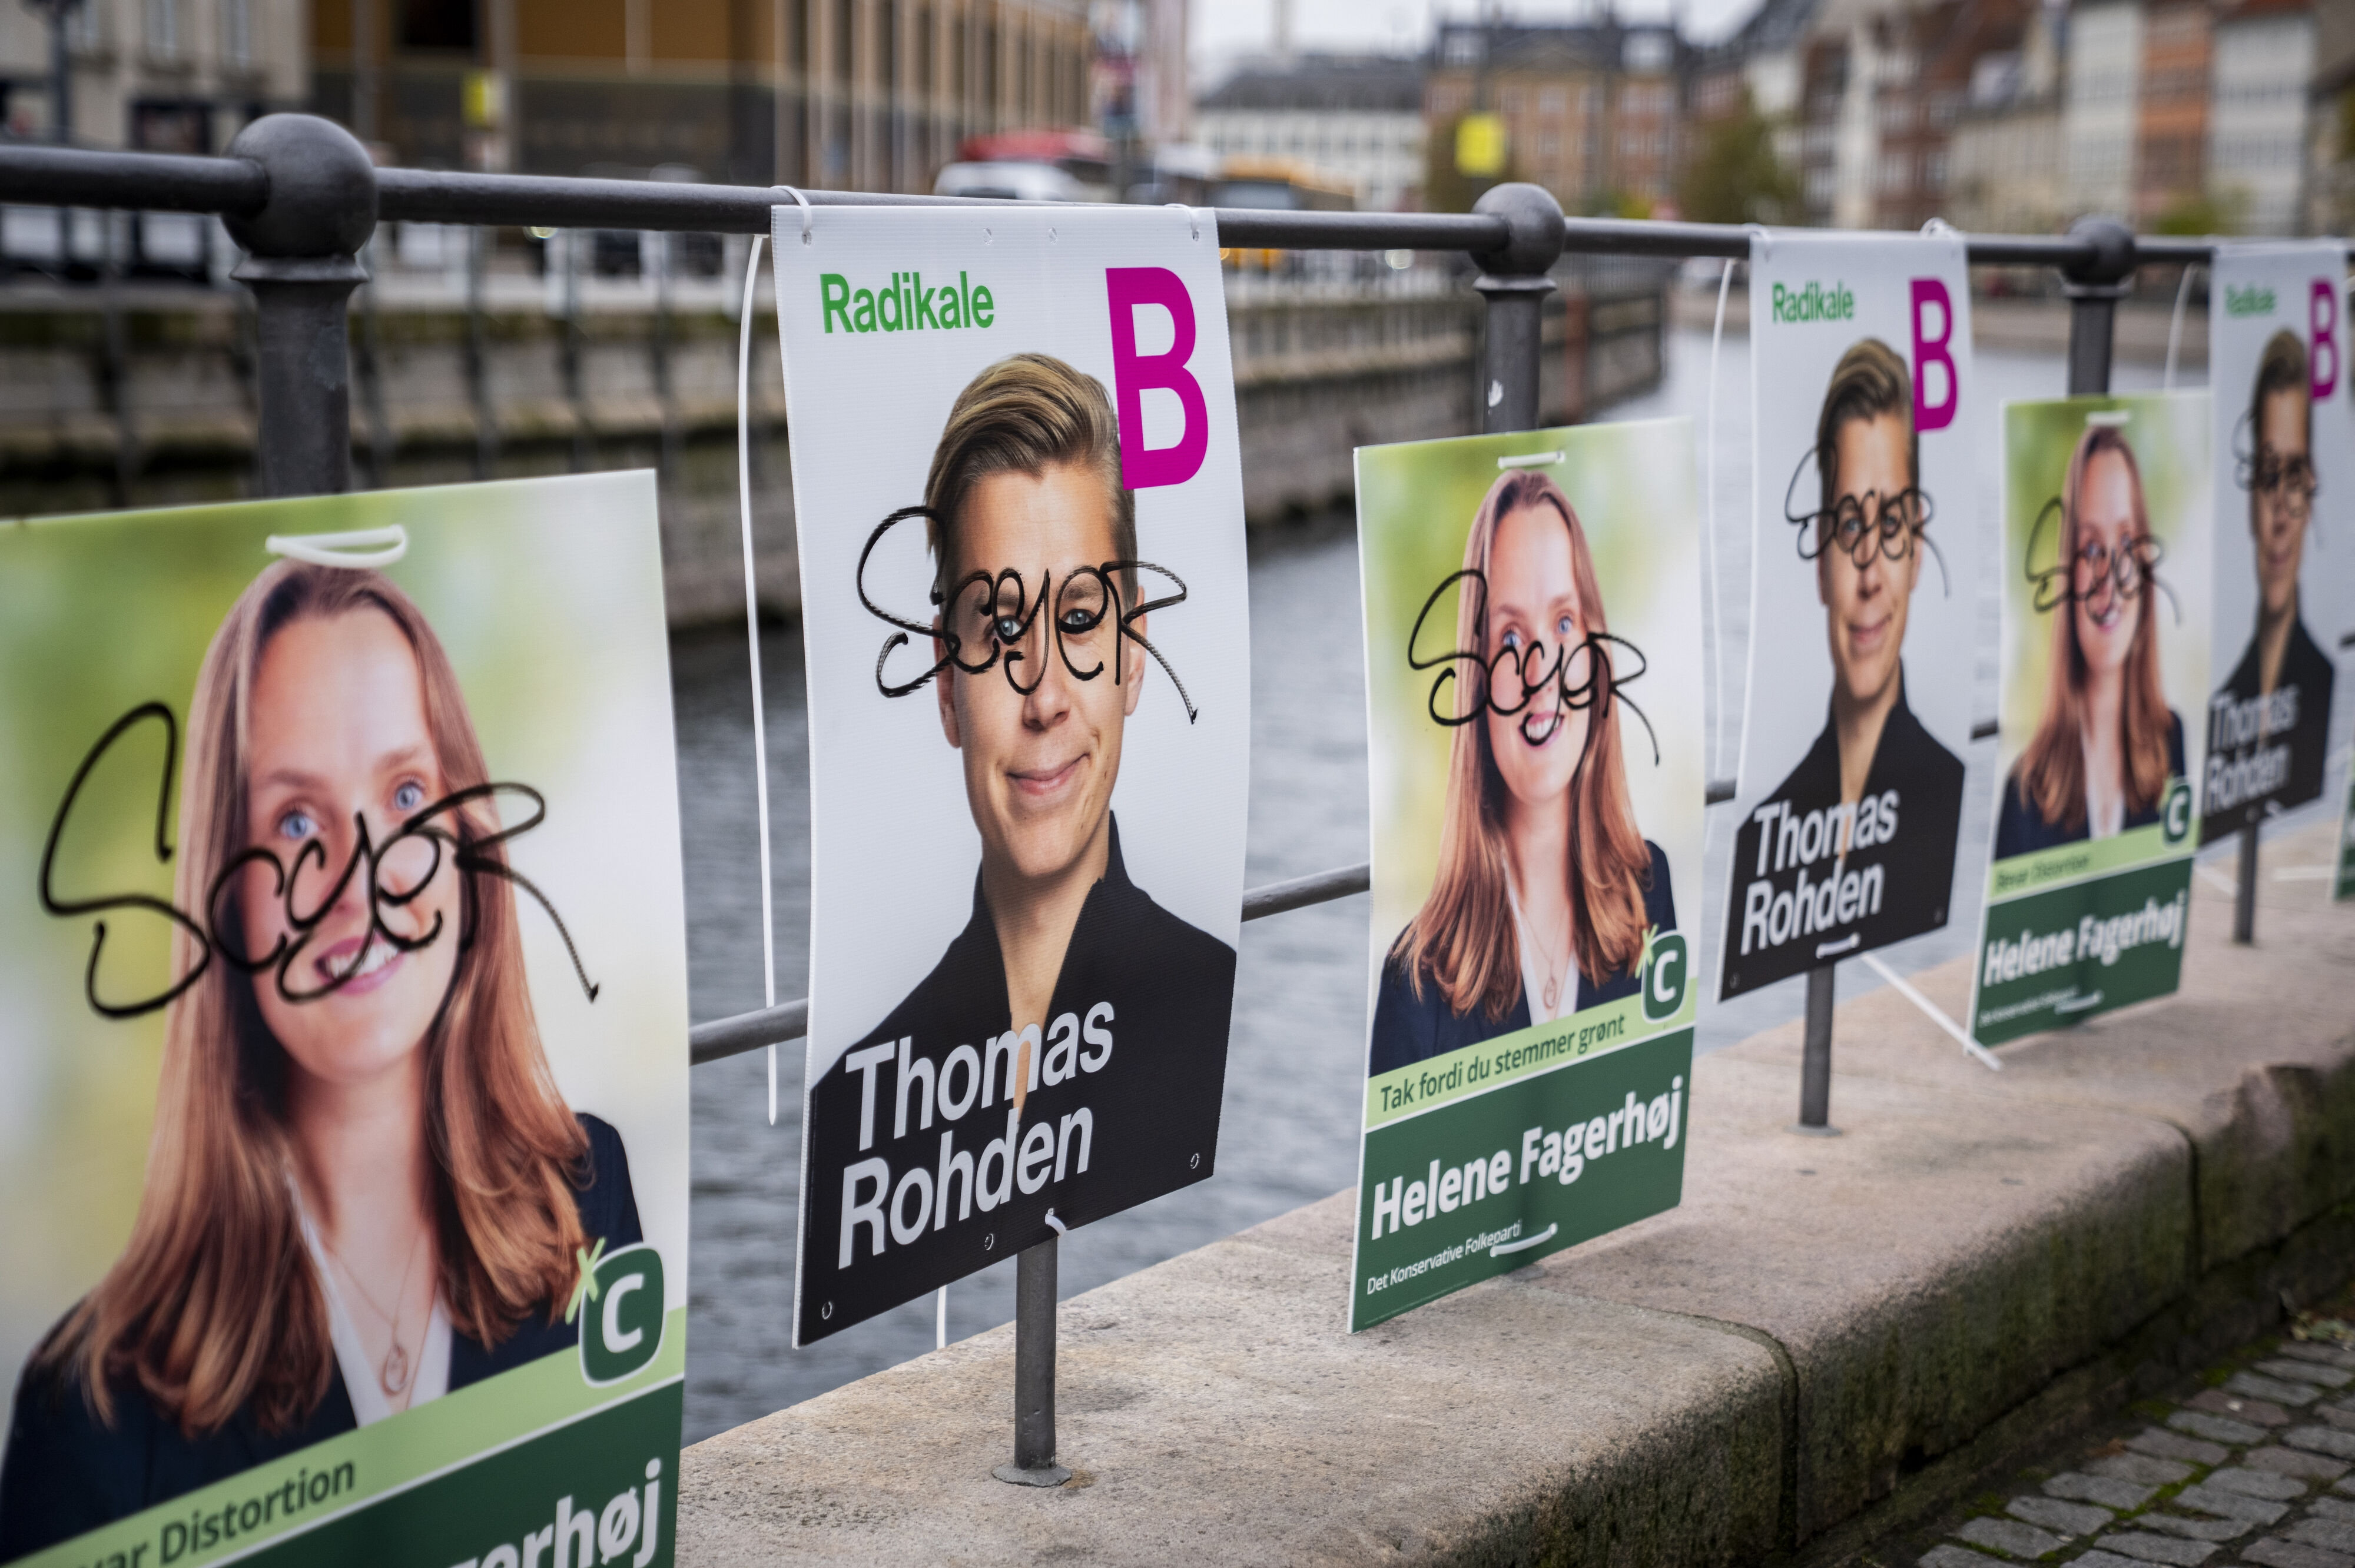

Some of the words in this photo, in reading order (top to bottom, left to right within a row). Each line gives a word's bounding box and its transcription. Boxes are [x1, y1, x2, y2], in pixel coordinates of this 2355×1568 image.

[820, 271, 994, 333] Radikale
[1772, 281, 1855, 324] Radikale
[2307, 277, 2340, 401] B
[1105, 267, 1208, 490] B
[1909, 278, 1959, 434] B
[1753, 789, 1900, 877] Thomas
[2168, 794, 2187, 836] C
[1740, 857, 1885, 956] Rohden
[1653, 950, 1678, 1002] C
[1983, 928, 2075, 987] Helene
[845, 1002, 1114, 1151] Thomas
[1381, 1078, 1415, 1112] Tak
[1419, 1061, 1463, 1099] fordi
[1467, 1056, 1490, 1083] du
[1494, 1031, 1575, 1075] stemmer
[1577, 1014, 1625, 1054] grønt
[838, 1107, 1093, 1270] Rohden
[1371, 1150, 1511, 1241] Helene
[1519, 1074, 1683, 1185] Fagerhøj
[1367, 1274, 1389, 1295] Det
[1390, 1245, 1463, 1285] Konservative
[1465, 1218, 1523, 1255] Folkeparti
[602, 1273, 645, 1354] C
[159, 1460, 355, 1566] Distortion
